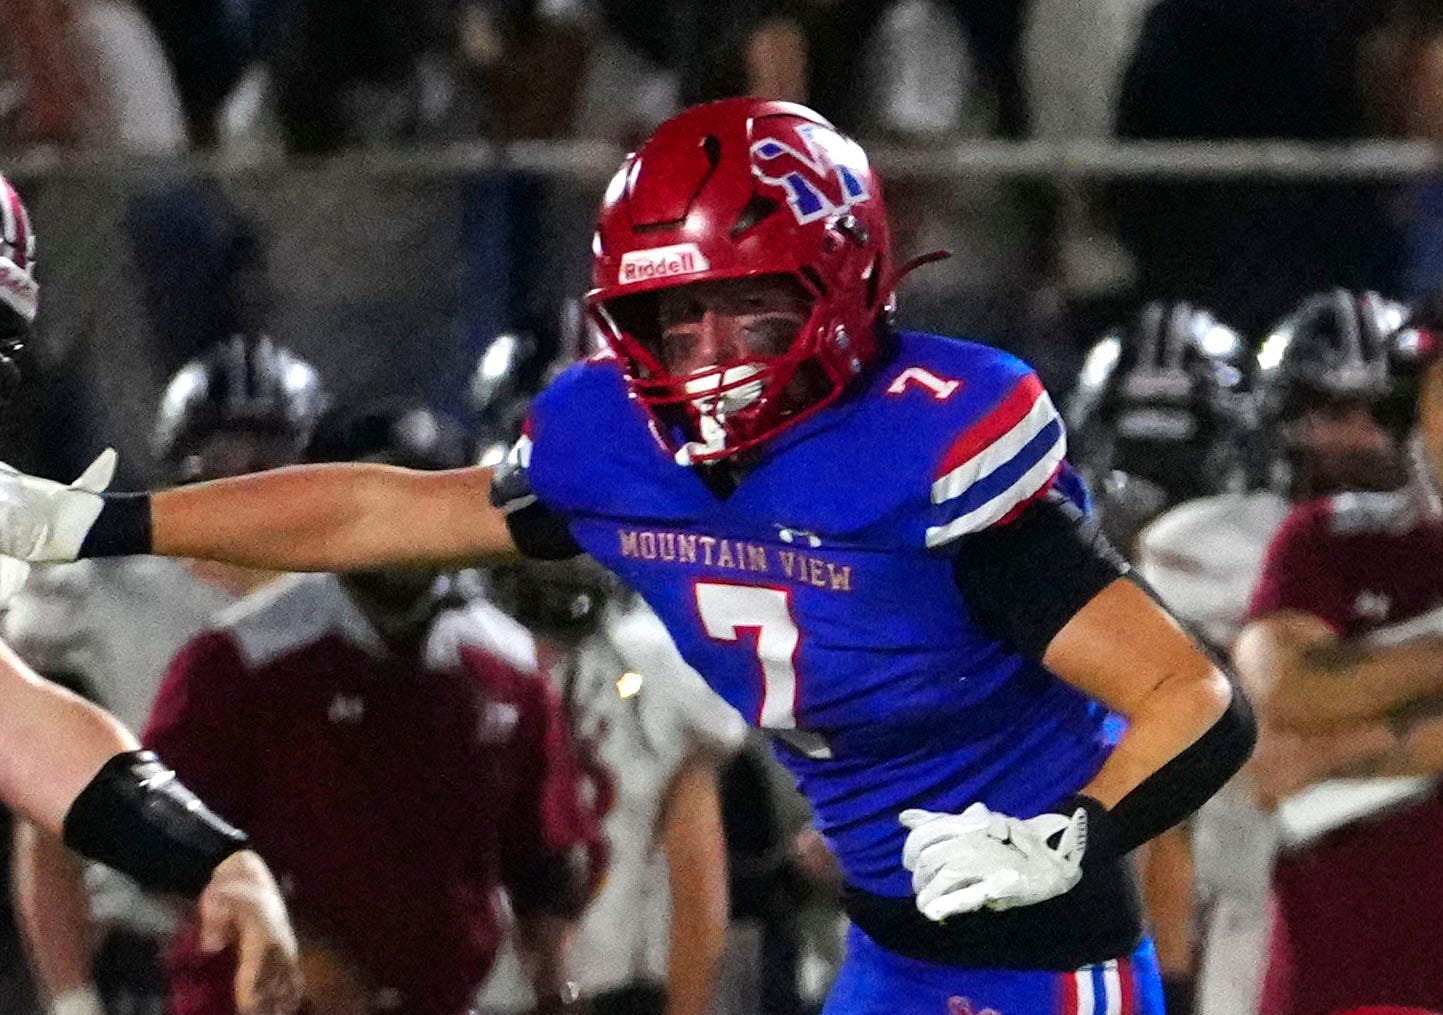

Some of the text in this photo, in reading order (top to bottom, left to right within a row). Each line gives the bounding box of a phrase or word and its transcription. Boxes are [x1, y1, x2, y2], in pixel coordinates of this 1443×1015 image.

[624, 252, 695, 281] Riddell
[885, 366, 961, 400] 7
[619, 529, 853, 592] MOUNTAIN VIEW
[693, 580, 802, 729] 7
